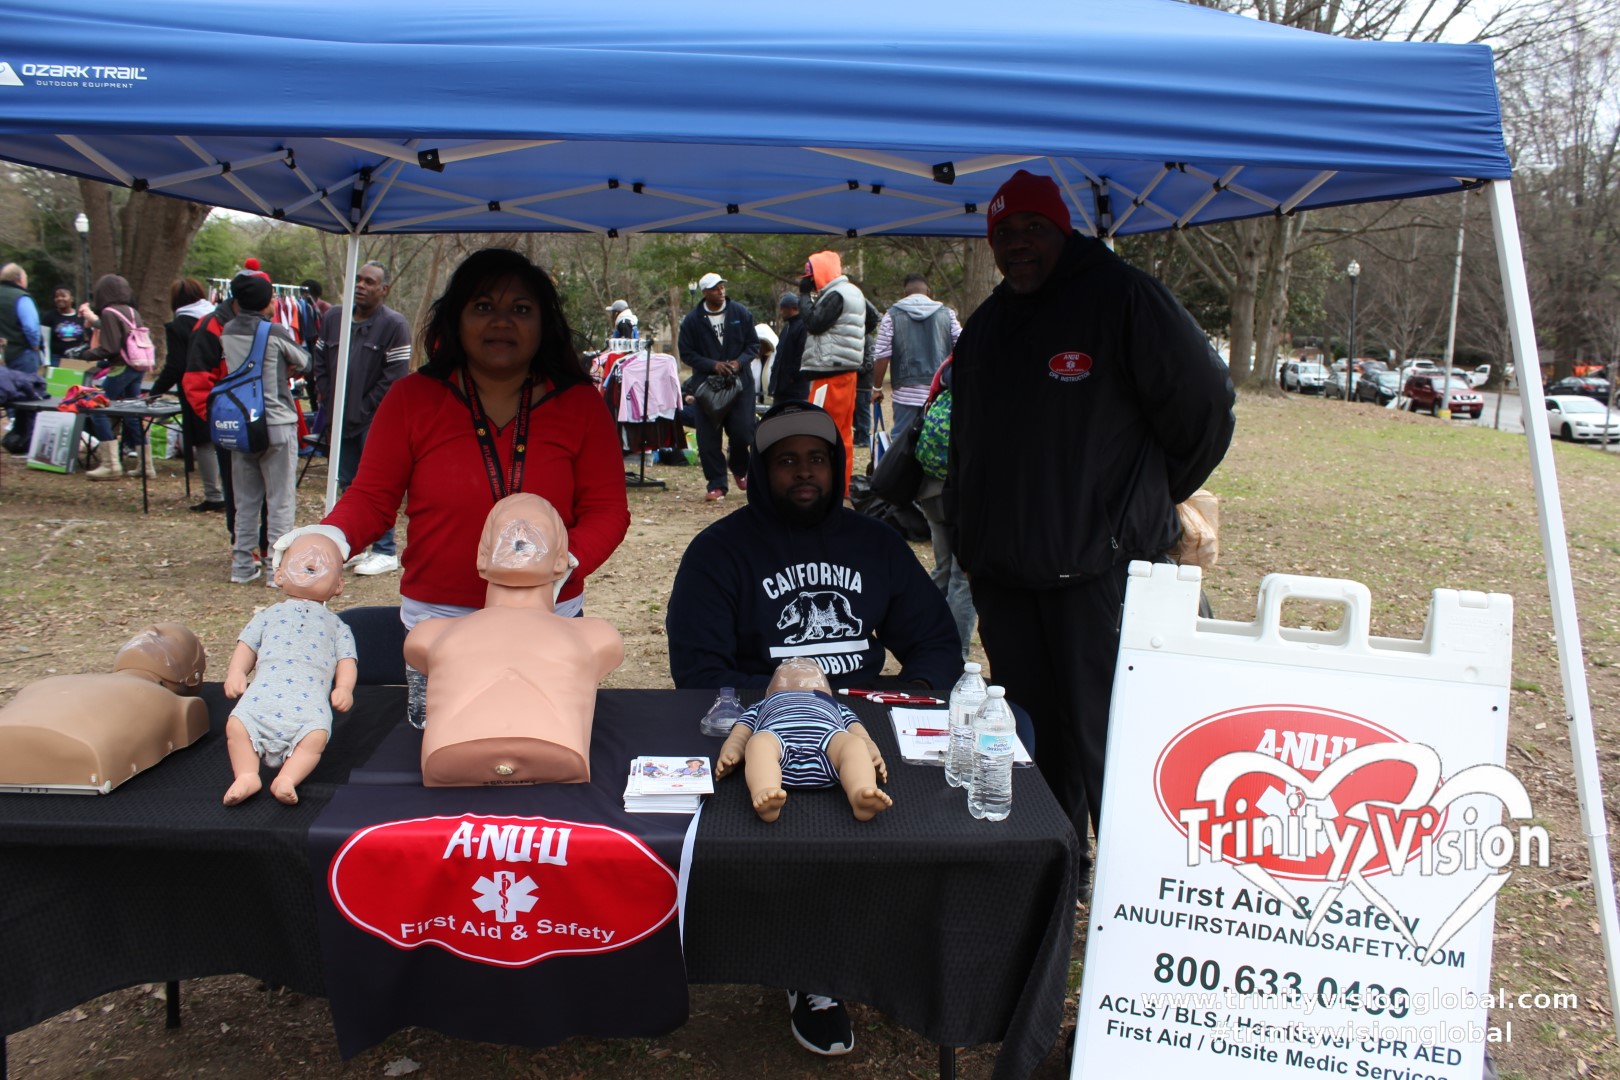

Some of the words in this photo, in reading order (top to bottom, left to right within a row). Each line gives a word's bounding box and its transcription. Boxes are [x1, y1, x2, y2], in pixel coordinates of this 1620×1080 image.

[21, 63, 90, 79] OZARK
[91, 66, 148, 80] TRAIL
[82, 81, 134, 89] EQUIPMENT
[762, 562, 862, 600] CALIFORNIA
[1159, 877, 1225, 909] First
[1231, 888, 1282, 916] Aid
[400, 914, 456, 939] First
[460, 920, 501, 940] Aid
[510, 925, 528, 940] &
[536, 919, 616, 943] Safety
[1113, 903, 1466, 968] ANUUFIRSTAIDANDSAFETY.COM
[1153, 952, 1410, 1019] 800.6330439
[1099, 994, 1157, 1018] ACLS
[1175, 1006, 1217, 1028] BLS
[1361, 1036, 1408, 1058] CPR
[1413, 1043, 1462, 1066] AED
[1107, 1019, 1152, 1042] First
[1157, 1028, 1192, 1049] Aid
[1210, 1037, 1278, 1063] Onsite
[1285, 1048, 1348, 1074] Medic
[1355, 1060, 1448, 1080] Servic
